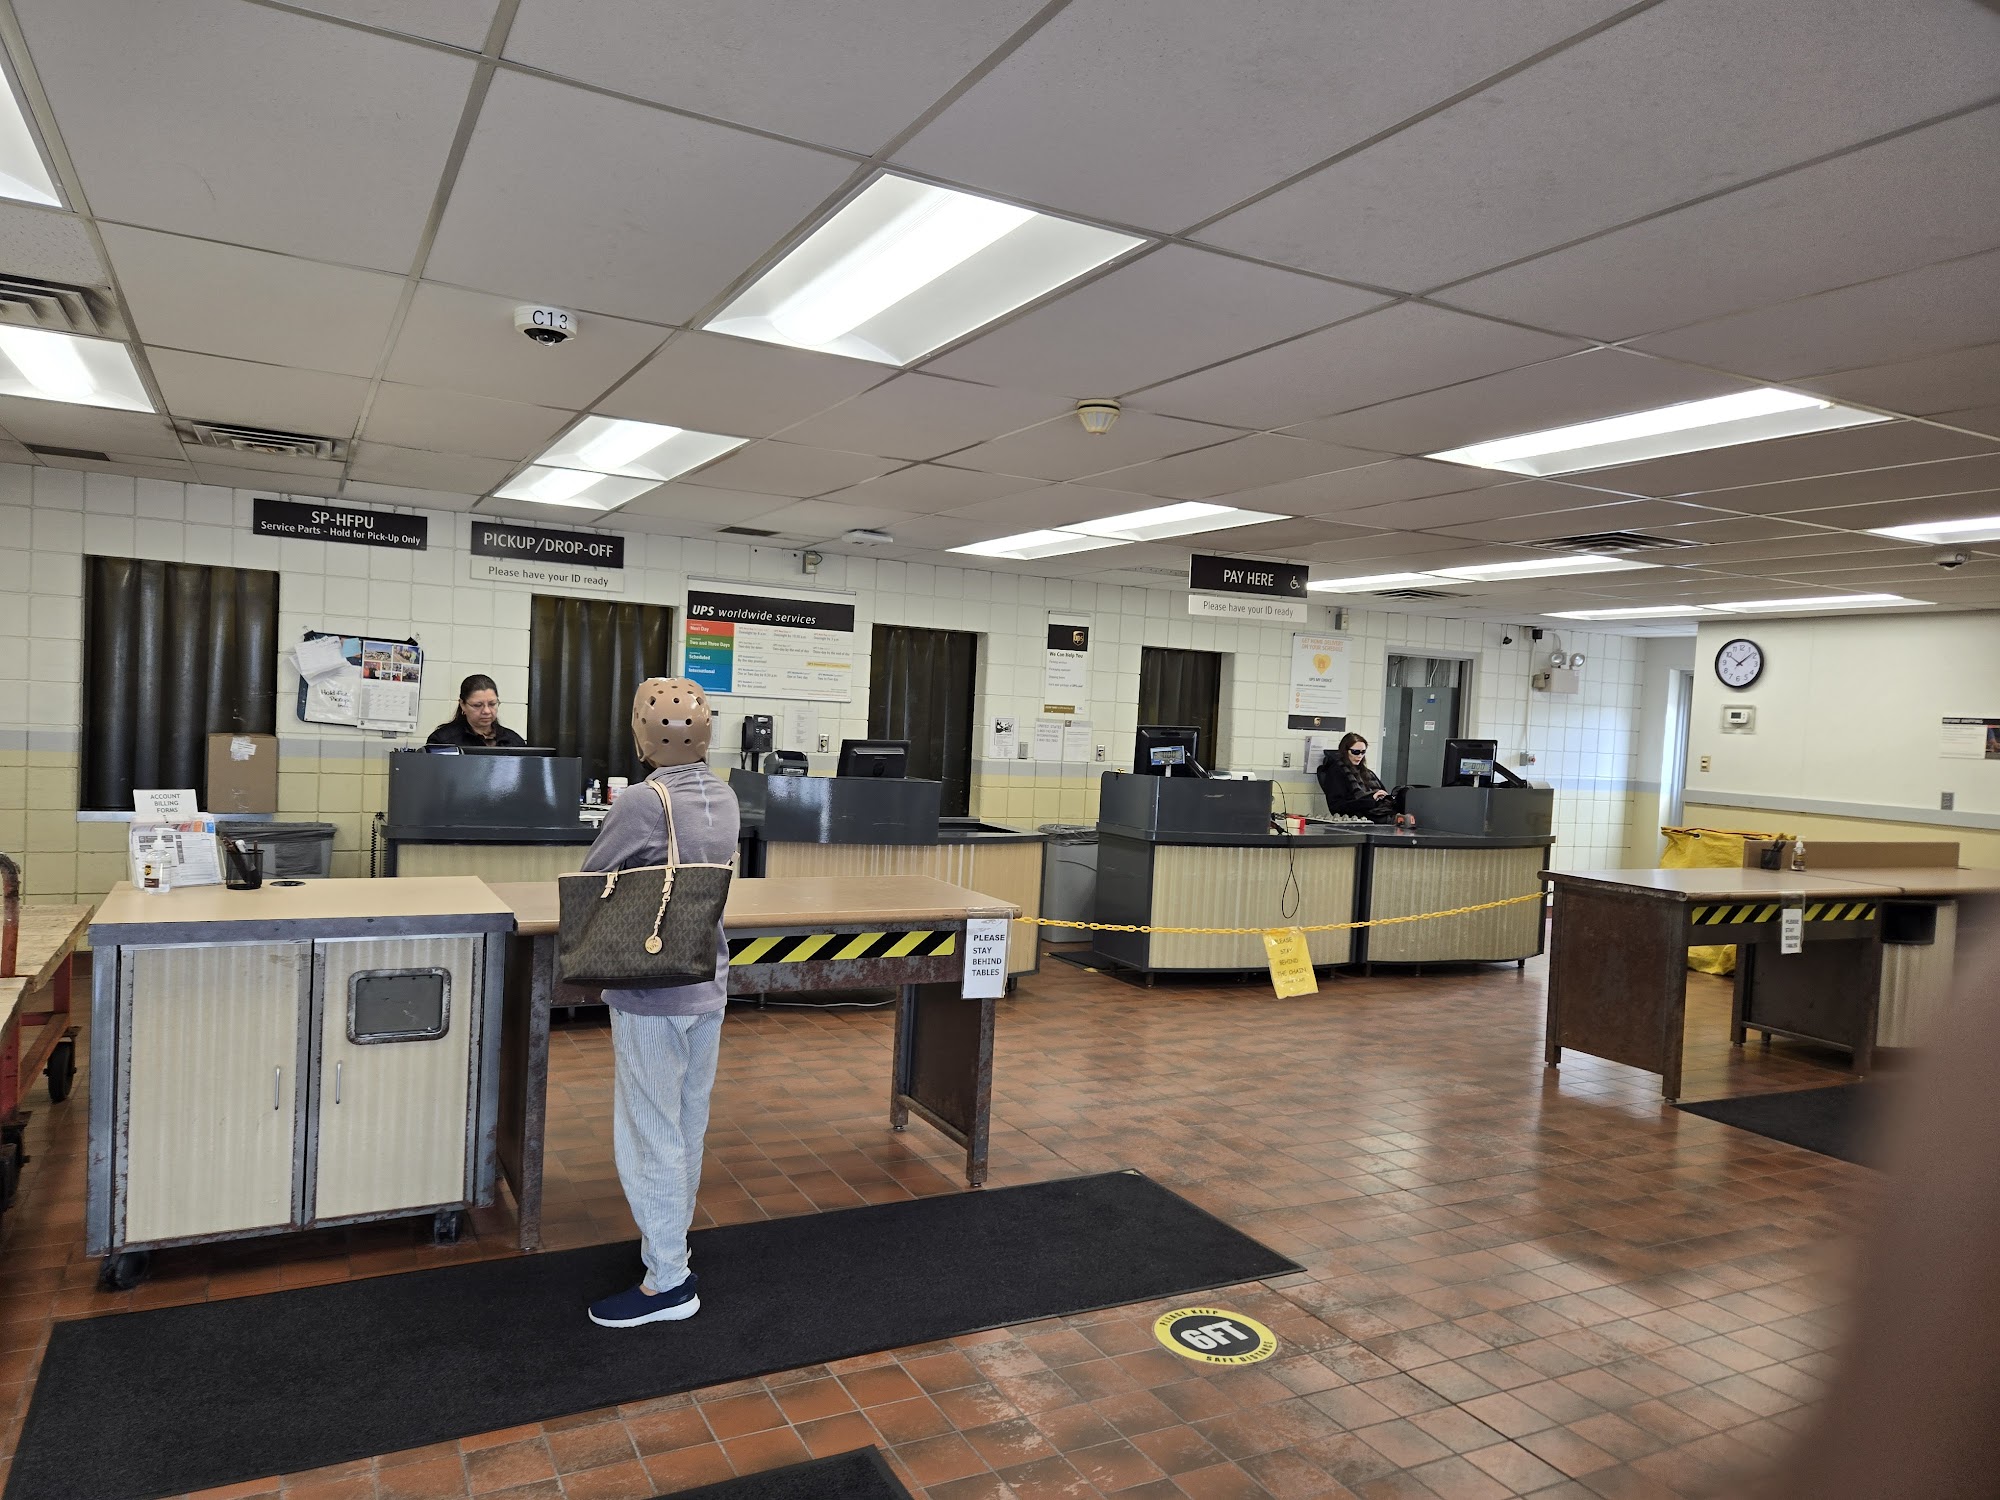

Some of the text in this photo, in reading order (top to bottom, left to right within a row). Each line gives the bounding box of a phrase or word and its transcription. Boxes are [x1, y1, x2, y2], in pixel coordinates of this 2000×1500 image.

[532, 310, 568, 329] C13
[311, 510, 374, 529] SP-HFPU
[261, 521, 295, 532] Service
[298, 525, 320, 535] Parts
[330, 528, 350, 537] Hold
[353, 530, 365, 538] for
[368, 532, 399, 543] Pick-Up
[401, 535, 420, 546] Only
[483, 532, 614, 558] PICKUP/DROP-OFF
[488, 566, 609, 587] Please have your ID ready
[1223, 570, 1274, 587] PAY HERE
[692, 604, 817, 625] UPS worldwide services
[1203, 601, 1294, 618] Please have your ID ready
[1159, 1311, 1187, 1326] PLEASE
[1181, 1320, 1249, 1350] 6FT
[1239, 1341, 1274, 1362] DISTANCE
